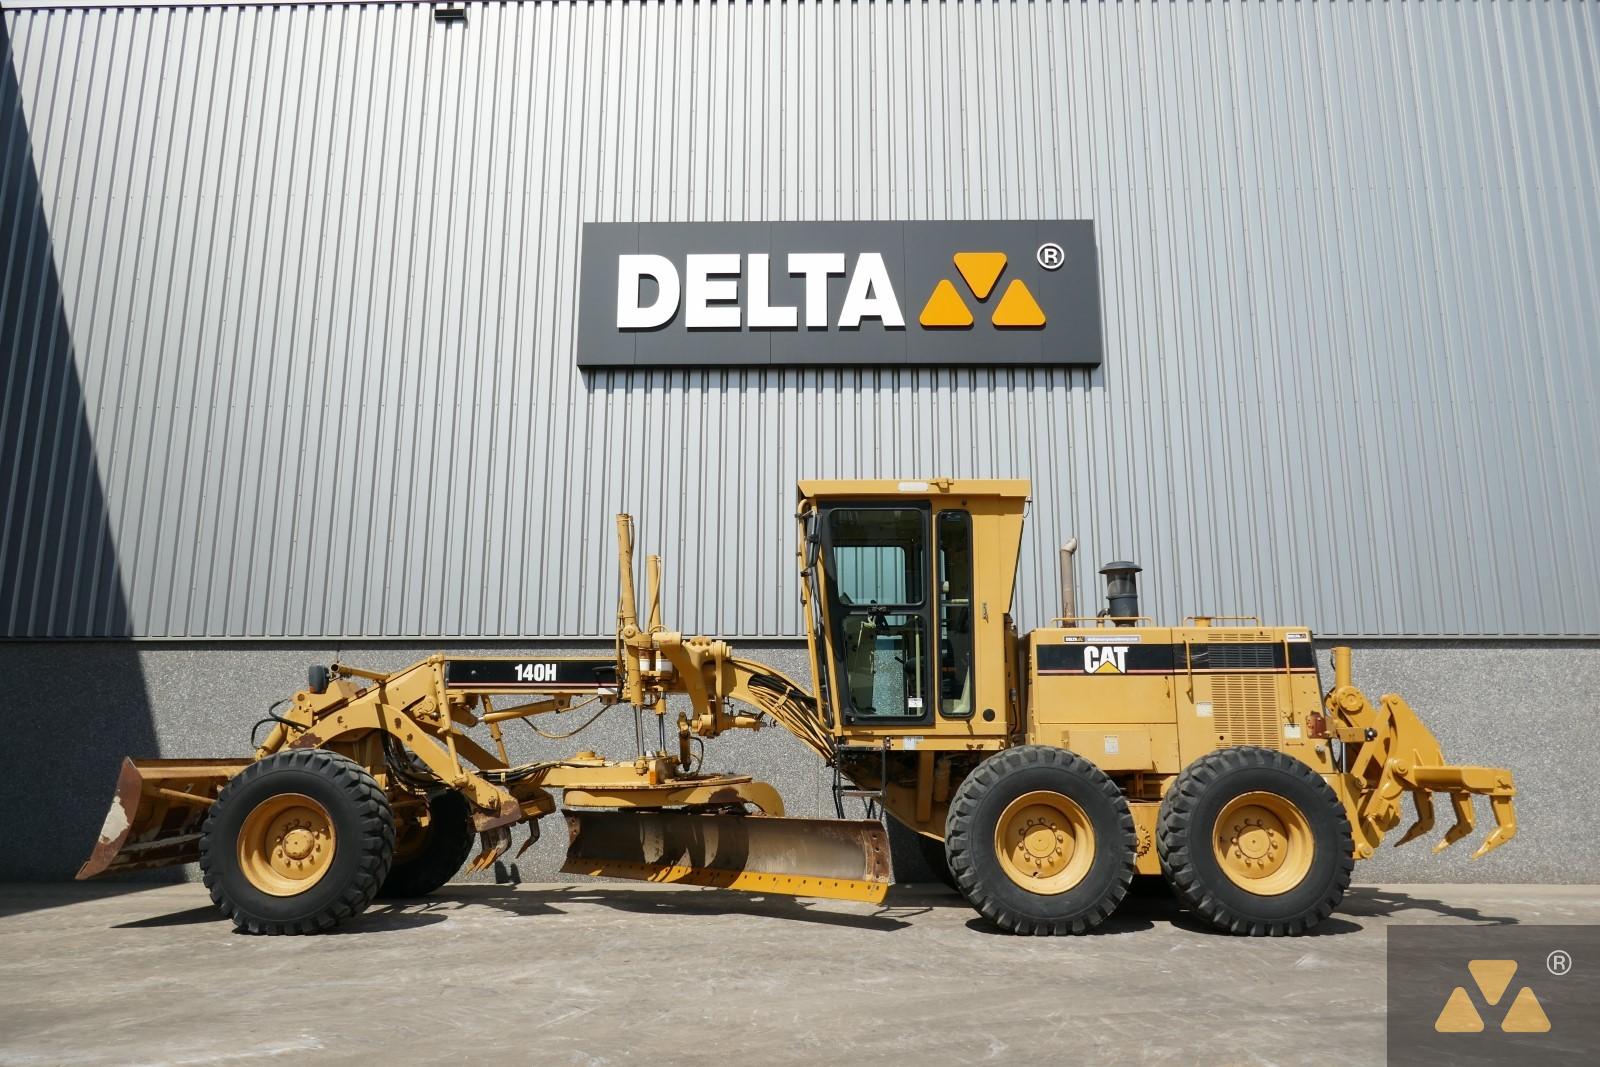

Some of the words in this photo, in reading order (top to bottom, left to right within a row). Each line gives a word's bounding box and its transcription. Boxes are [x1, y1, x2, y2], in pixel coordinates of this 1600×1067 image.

[616, 252, 906, 329] DELTA
[514, 663, 558, 682] 140H
[1083, 645, 1130, 674] CAT
